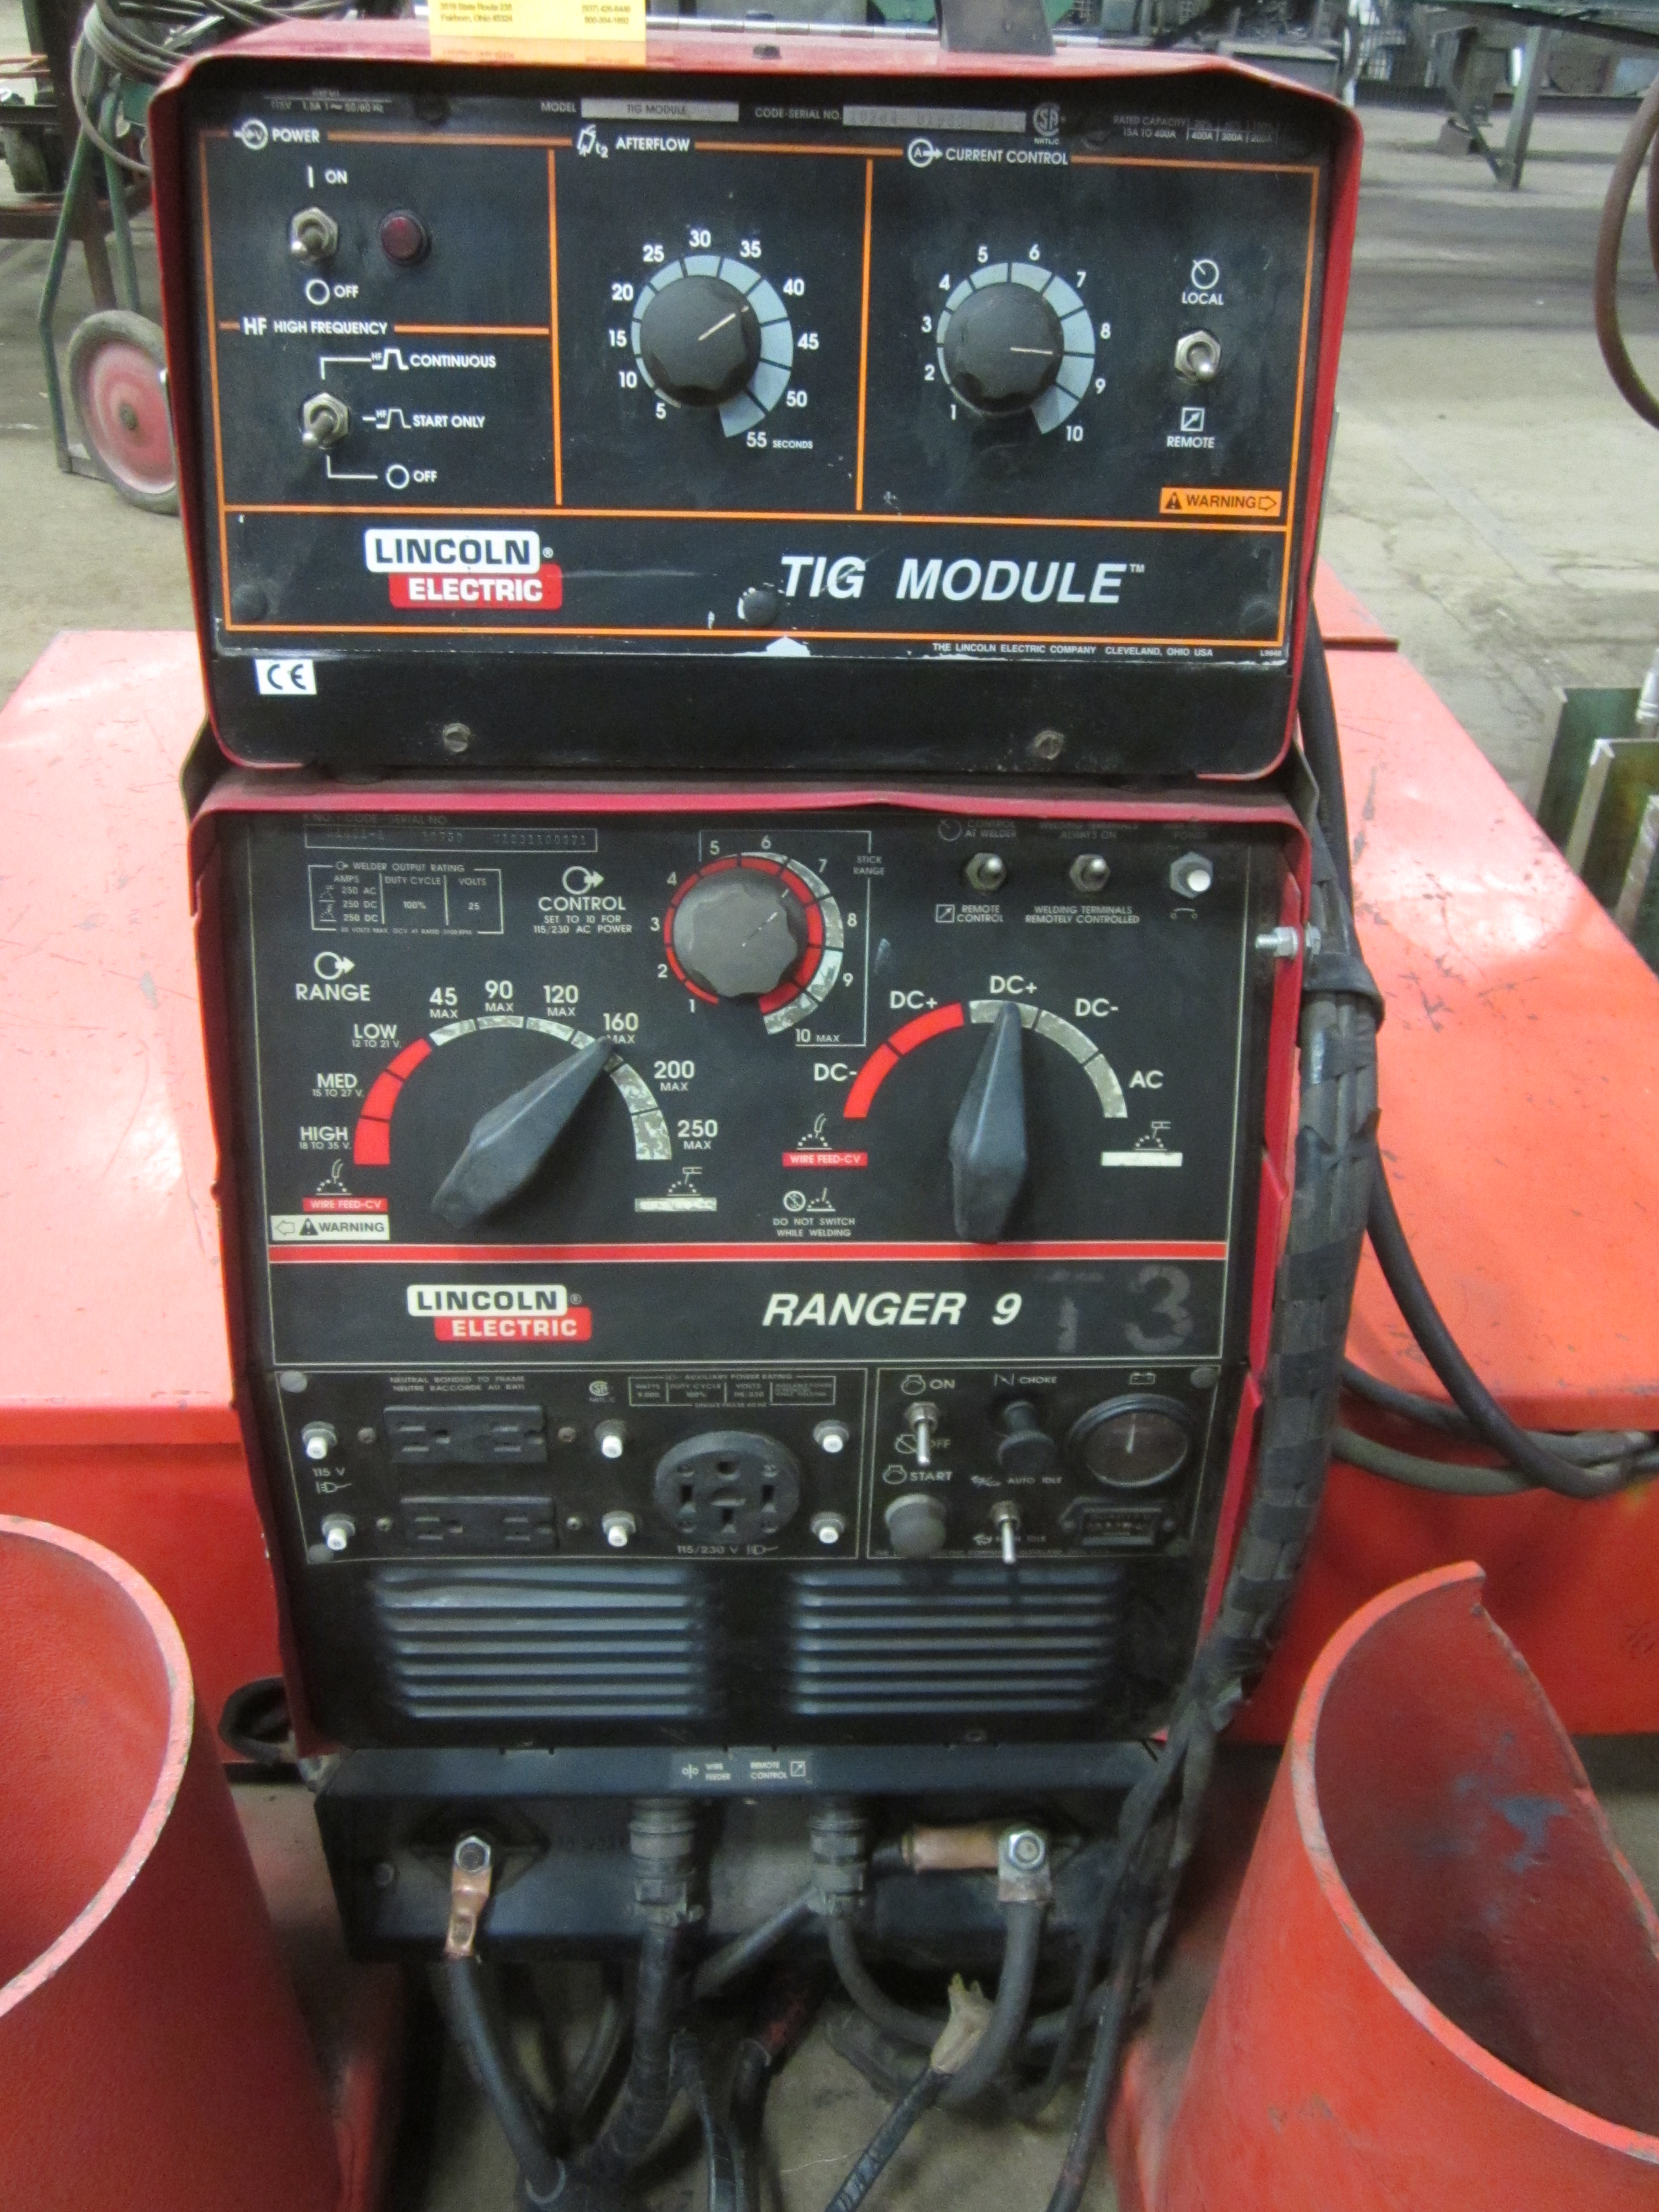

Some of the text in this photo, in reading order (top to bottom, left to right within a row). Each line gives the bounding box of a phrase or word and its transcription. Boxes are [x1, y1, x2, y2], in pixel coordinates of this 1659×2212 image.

[540, 101, 576, 113] MODEL
[272, 128, 320, 144] POWER
[616, 136, 690, 152] AFTERFLOW
[945, 148, 1068, 165] CURRENT CONTROL
[325, 170, 348, 184] ON
[690, 229, 711, 248] 30
[643, 245, 665, 263] 25
[740, 240, 762, 258] 35
[978, 247, 989, 263] 5
[1029, 244, 1040, 261] 6
[939, 274, 951, 291] 4
[1076, 271, 1087, 287] 7
[333, 285, 359, 299] OFF
[612, 284, 634, 302] 20
[783, 278, 805, 296] 40
[1182, 291, 1224, 306] LOCAL
[244, 317, 388, 336] HF HIGH FREQUENCY
[921, 316, 932, 333] 3
[1100, 323, 1112, 340] 8
[609, 330, 627, 348] 15
[797, 332, 820, 351] 45
[410, 353, 497, 369] CONTINUOUS
[619, 371, 638, 389] 10
[924, 364, 936, 381] 2
[1095, 378, 1106, 394] 9
[786, 390, 808, 408] 50
[655, 403, 667, 420] 5
[950, 405, 957, 420] 1
[413, 414, 486, 429] START ONLY
[746, 431, 813, 450] 55 SECONDS
[1066, 425, 1084, 442] 10
[1167, 436, 1215, 449] REMOTE
[413, 469, 438, 483] OFF
[1186, 494, 1257, 510] WARNING
[375, 538, 531, 566] LINCOLN
[780, 556, 1127, 604] TIG MODULE
[408, 577, 543, 603] ELECTRIC
[932, 642, 1214, 658] THE LINCOLN ELECTRIC COMPANY CLEVELAND, OHIO USA
[710, 841, 719, 855] 5
[761, 835, 771, 849] 6
[353, 862, 387, 871] WELDER
[392, 863, 425, 872] OUTPUT
[818, 858, 827, 873] 7
[856, 855, 882, 864] STICK
[667, 872, 677, 885] 4
[853, 867, 885, 875] RANGE
[333, 875, 487, 886] AMPS DUTY CYCLE VOLTS
[363, 886, 378, 895] AC
[343, 900, 481, 910] 250 DC 25
[538, 896, 627, 912] CONTROL
[962, 905, 1000, 913] REMOTE
[1034, 905, 1133, 914] WELDING TERMINALS
[343, 914, 379, 922] 250 DC
[601, 915, 621, 924] FOR
[650, 917, 660, 931] 3
[847, 912, 857, 927] 8
[957, 914, 1004, 923] CONTROL
[1025, 915, 1140, 924] REMOTELY CONTROLLED
[576, 925, 633, 933] AC POWER
[657, 963, 667, 978] 2
[843, 973, 853, 987] 9
[989, 975, 1037, 994] DC+
[295, 983, 371, 1001] RANGE
[429, 987, 458, 1006] 45
[485, 980, 513, 999] 90
[542, 984, 579, 1004] 120
[485, 1002, 514, 1012] MAX
[689, 999, 695, 1013] 1
[889, 990, 937, 1009] DC+
[430, 1008, 458, 1019] MAX
[547, 1006, 576, 1017] MAX
[1074, 998, 1119, 1017] DC-
[603, 1012, 639, 1032] 160
[353, 1024, 398, 1040] LOW
[795, 1029, 840, 1043] 10 MAX
[352, 1040, 361, 1048] 12
[654, 1060, 695, 1079] 200
[813, 1063, 858, 1082] DC-
[317, 1073, 357, 1088] MED
[660, 1081, 688, 1092] MAX
[1129, 1070, 1164, 1088] AC
[300, 1126, 349, 1141] HIGH
[677, 1119, 718, 1139] 250
[684, 1140, 712, 1150] MAX
[790, 1155, 862, 1164] WIRE FEED-CV
[310, 1199, 381, 1209] WIRE FEED-CV
[319, 1222, 384, 1233] WARNING
[773, 1218, 855, 1226] DO NOT SWITCH
[776, 1229, 852, 1238] WHILE WELDING
[416, 1290, 557, 1312] LINCOLN
[763, 1292, 1022, 1326] RANGER 9
[451, 1317, 579, 1337] ELECTRIC
[929, 1378, 955, 1390] ON
[1020, 1376, 1057, 1384] CHOKE
[312, 1467, 346, 1477] 115 V
[909, 1471, 953, 1481] START
[750, 1771, 788, 1780] CONTROL
